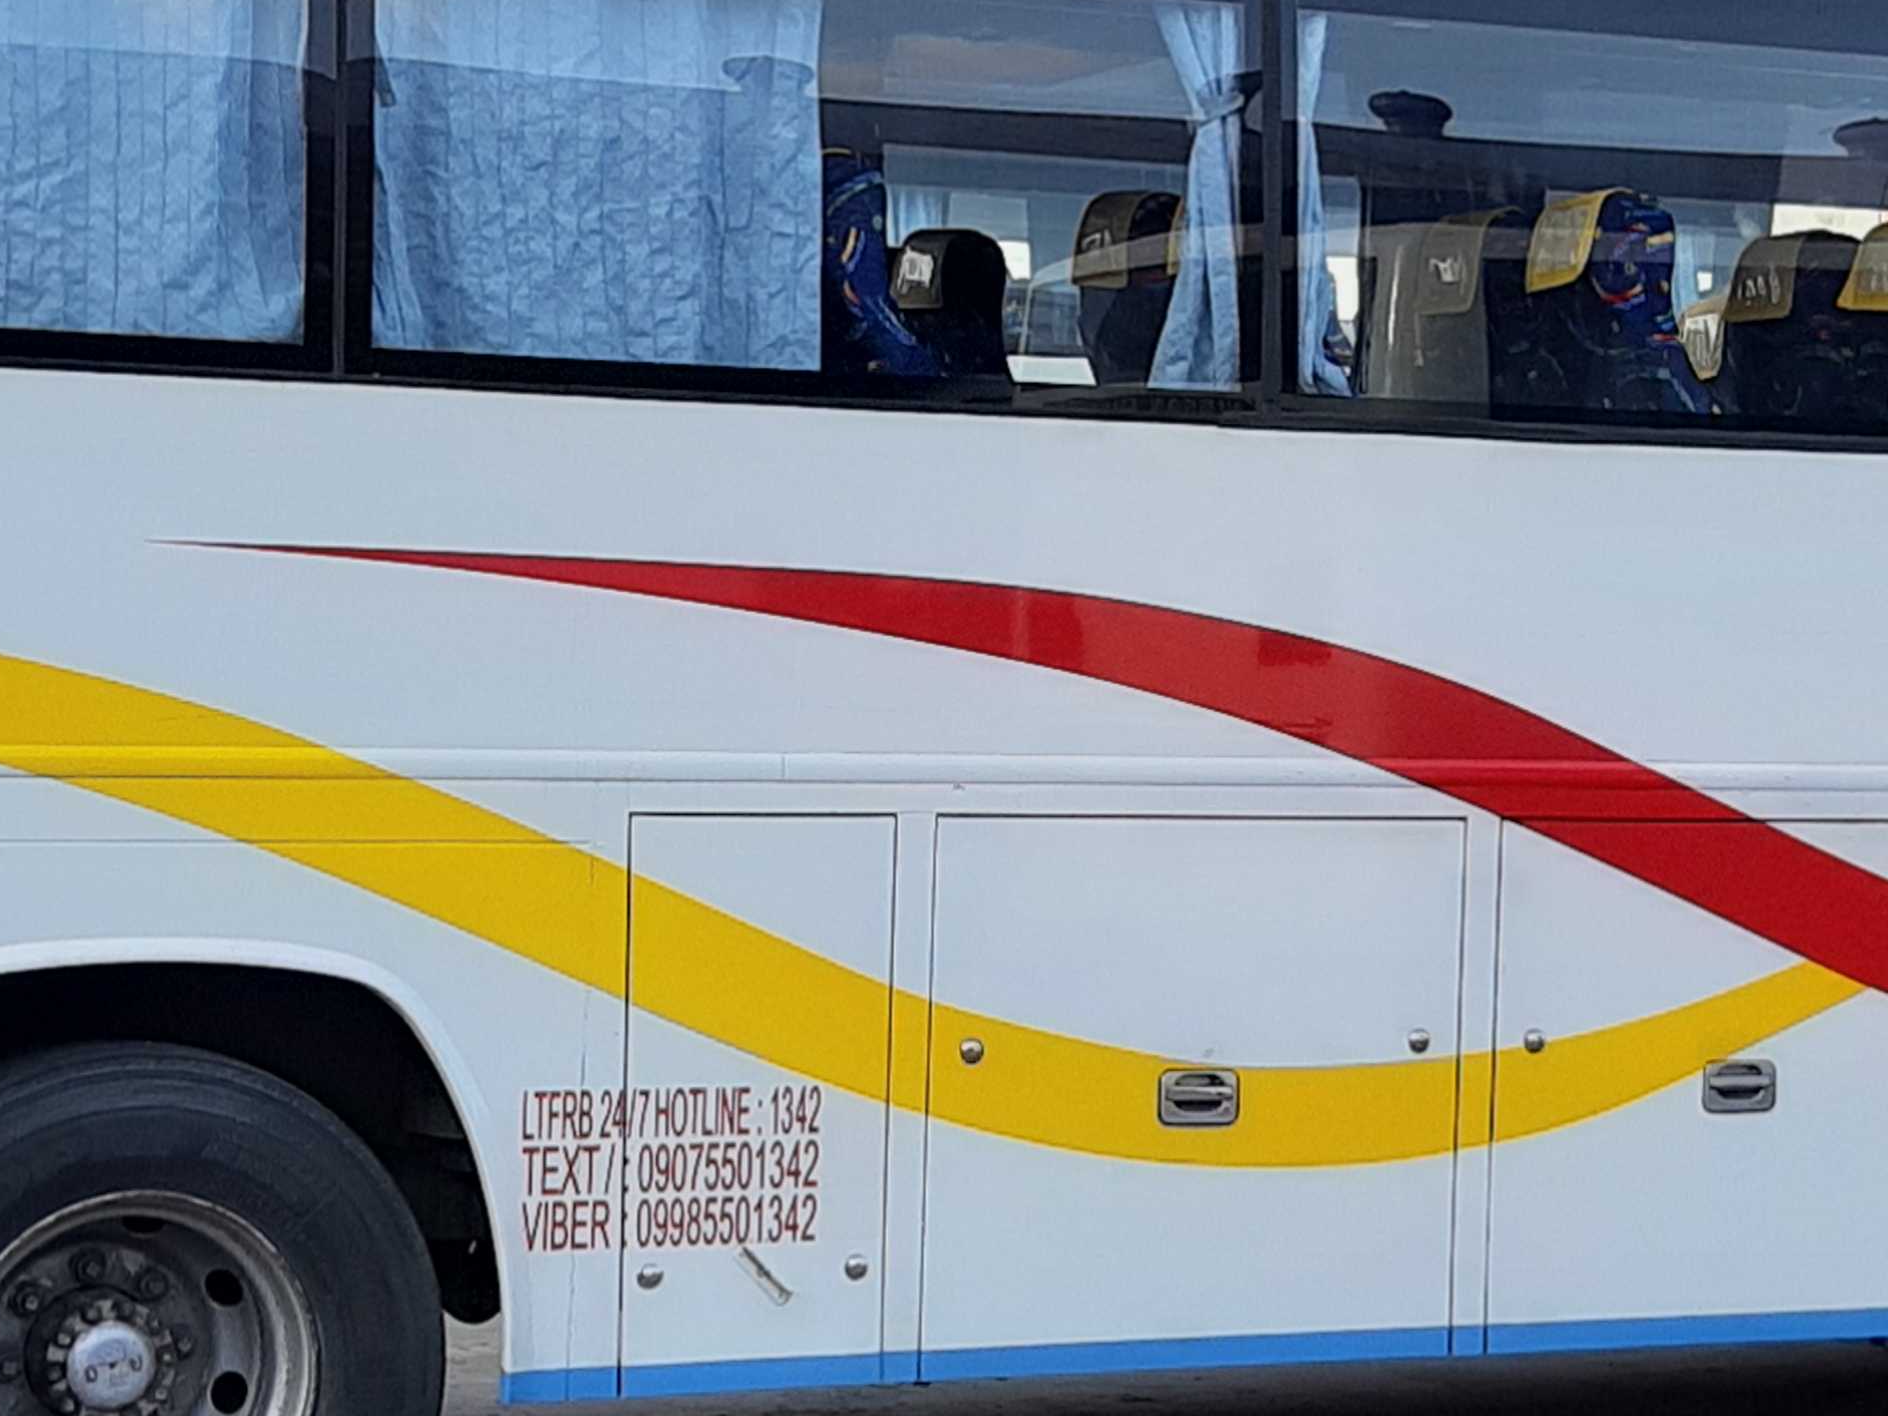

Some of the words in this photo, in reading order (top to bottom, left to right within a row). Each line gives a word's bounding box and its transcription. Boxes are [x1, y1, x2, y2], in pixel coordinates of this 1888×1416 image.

[521, 1089, 594, 1140] LTFRB
[599, 1088, 650, 1139] 24/7
[655, 1086, 752, 1138] HOTLINE
[771, 1084, 822, 1135] 1342
[521, 1144, 601, 1196] TEXT
[637, 1139, 821, 1193] 09075501342
[521, 1199, 612, 1252] VIBER
[635, 1193, 818, 1248] 09985501342
